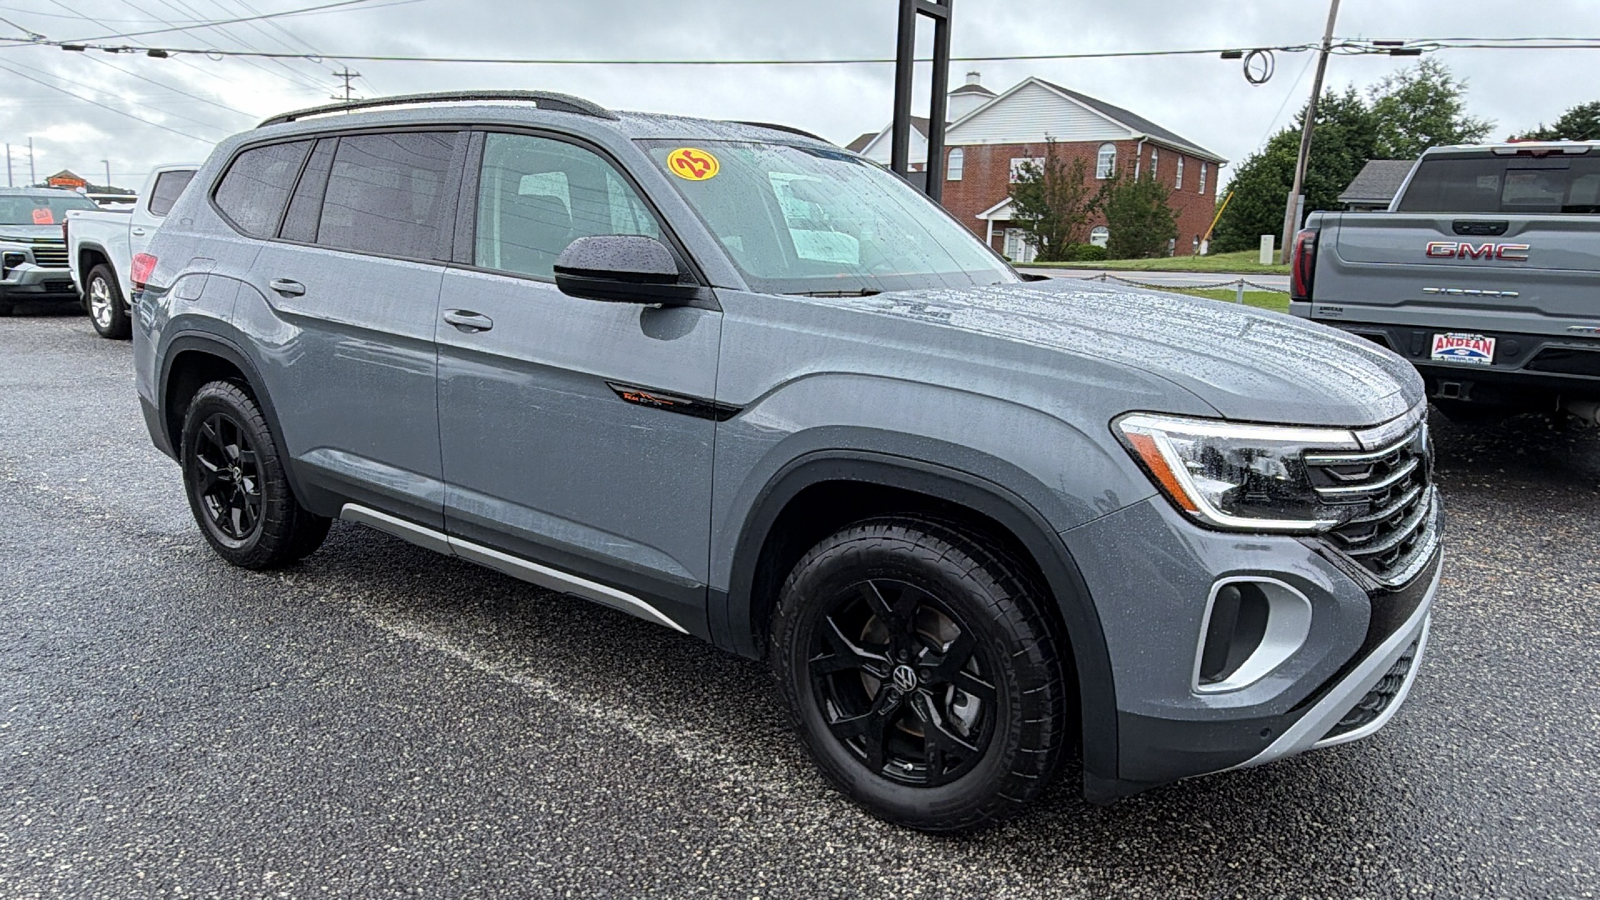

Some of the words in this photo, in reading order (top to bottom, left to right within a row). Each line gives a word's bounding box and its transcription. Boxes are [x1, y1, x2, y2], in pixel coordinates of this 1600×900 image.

[676, 150, 711, 178] 25
[1426, 241, 1531, 261] GMC
[1435, 337, 1492, 355] ANDEAN
